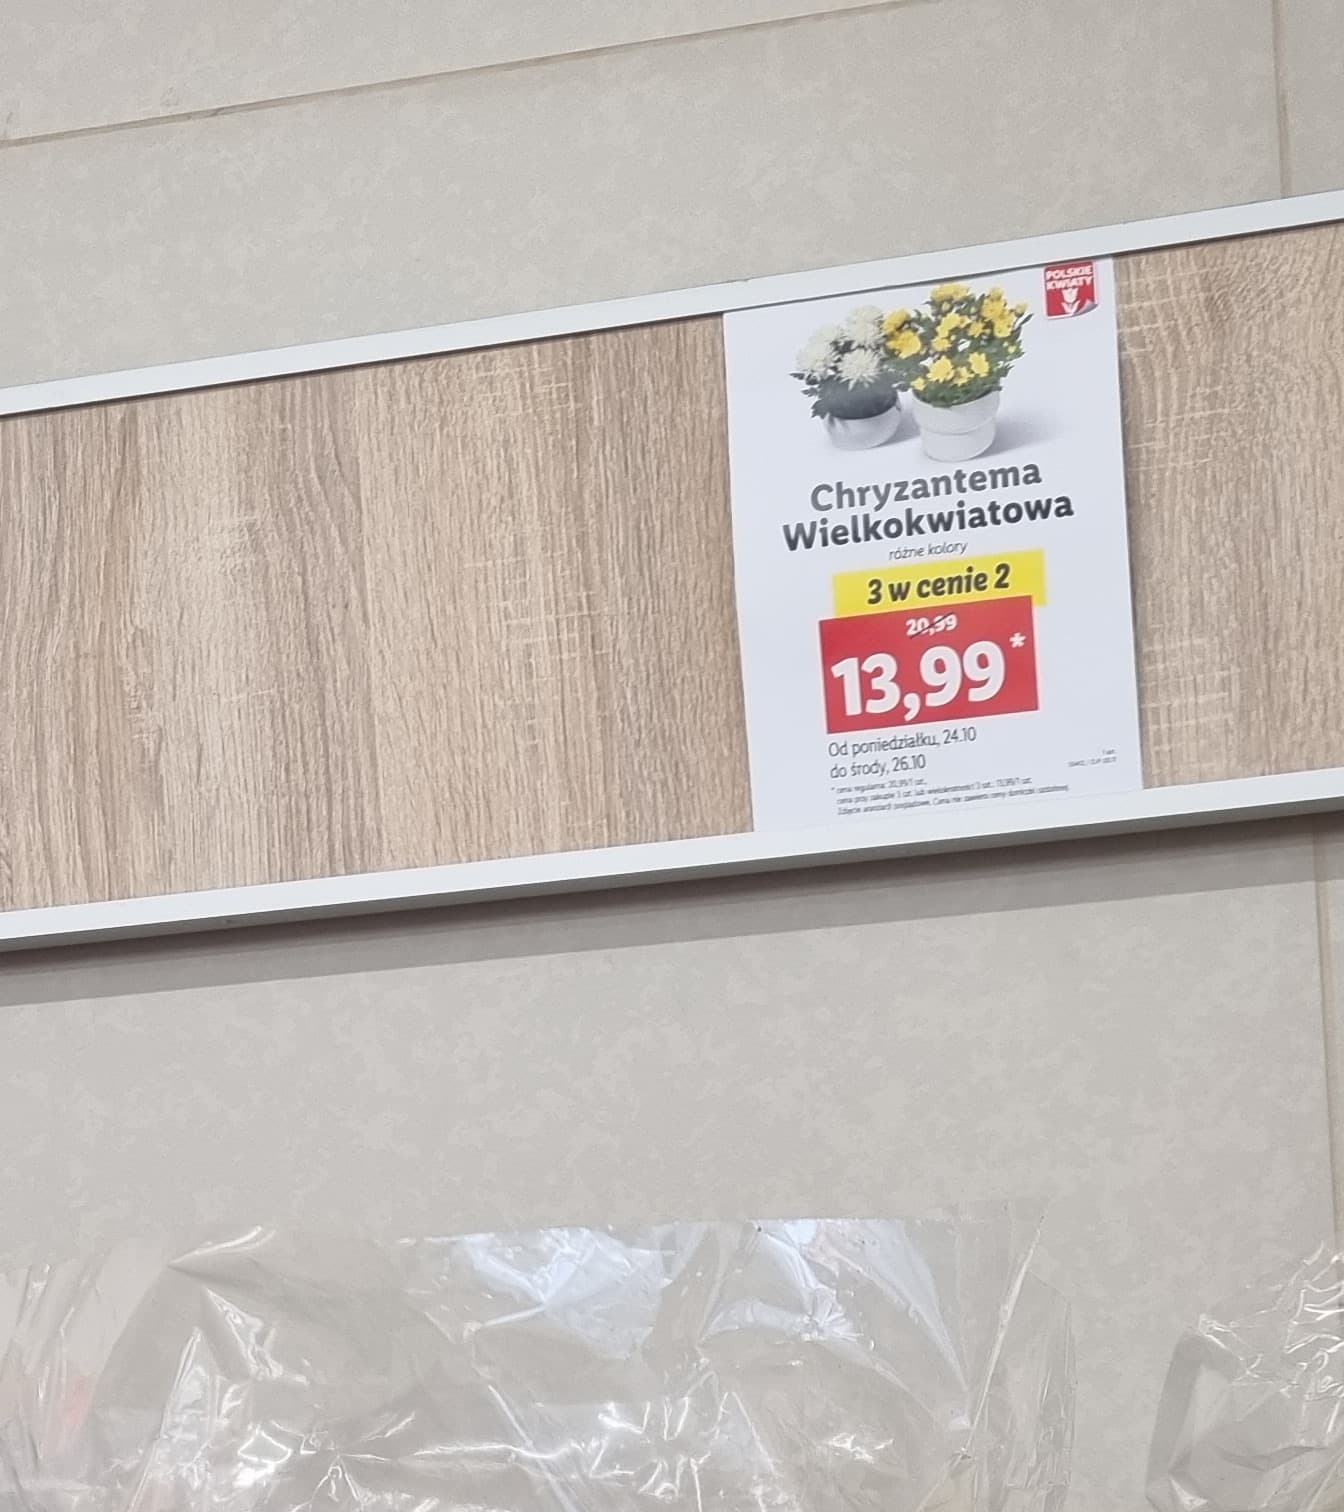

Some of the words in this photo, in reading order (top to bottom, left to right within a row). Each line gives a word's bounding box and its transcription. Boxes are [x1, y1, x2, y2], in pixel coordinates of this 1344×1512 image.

[1047, 265, 1093, 280] POLSKIE
[1047, 276, 1093, 290] KWIATY
[811, 463, 1042, 512] Chryzantema
[783, 495, 1074, 551] Wielkokwiatowa
[889, 546, 925, 560] różne
[927, 541, 968, 558] kolory
[867, 578, 882, 604] 3
[888, 582, 912, 602] w
[917, 567, 989, 599] cenie
[994, 563, 1011, 589] 2
[828, 741, 849, 757] Od
[943, 726, 977, 745] 24.10
[830, 763, 847, 778] do
[892, 754, 926, 772] 26.10
